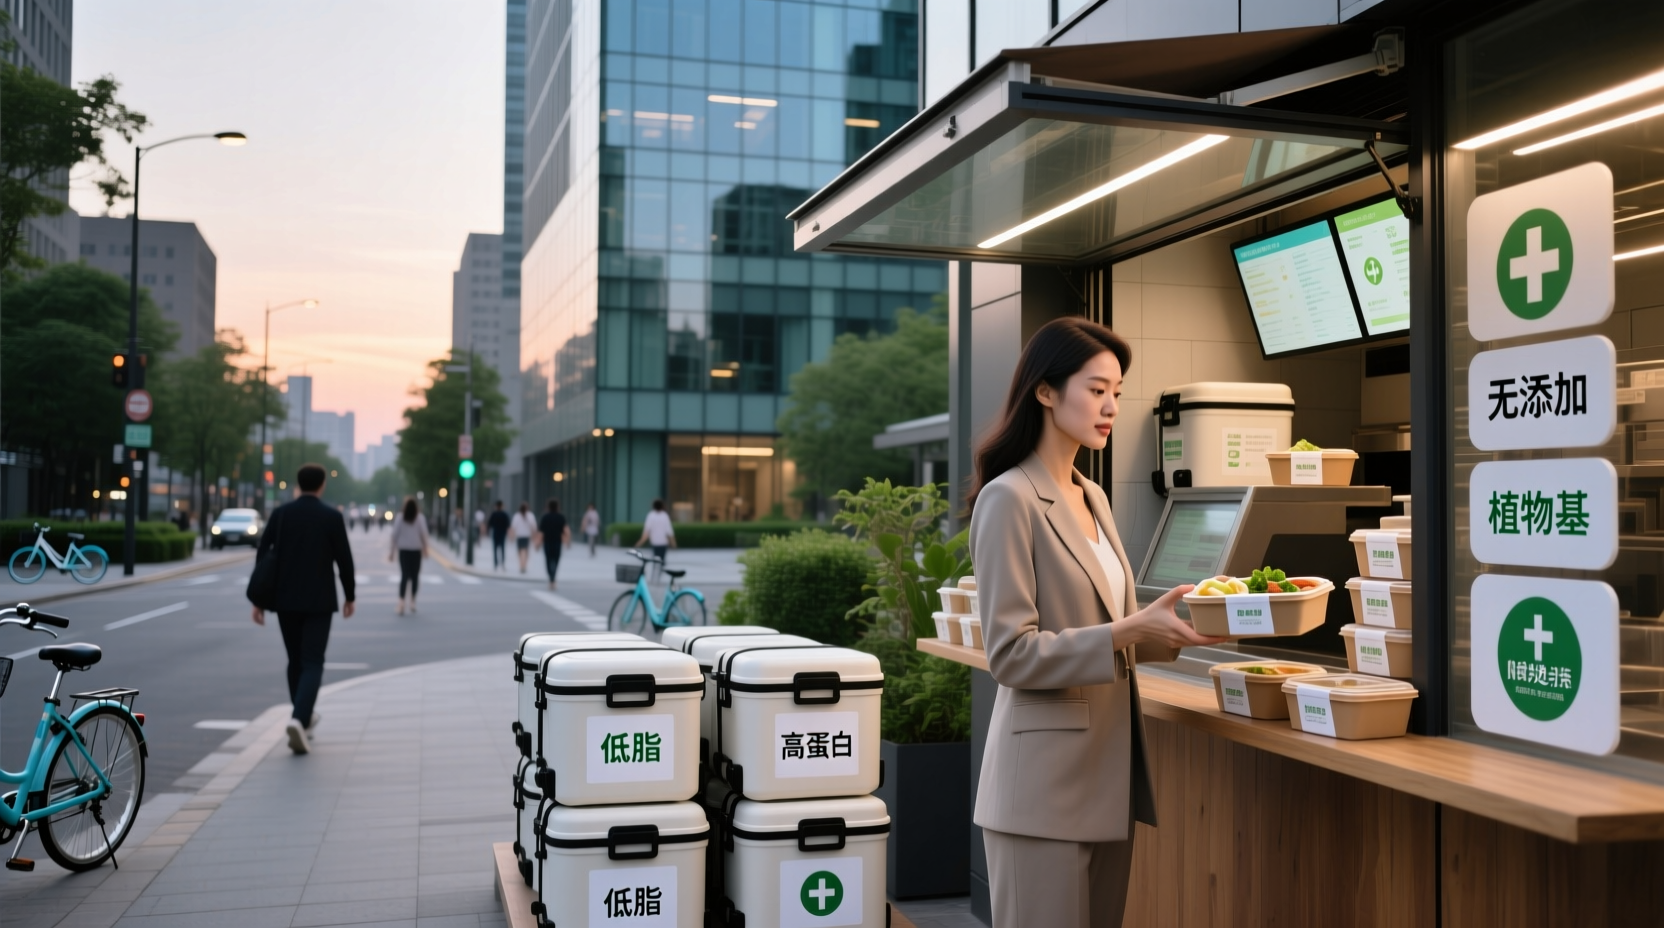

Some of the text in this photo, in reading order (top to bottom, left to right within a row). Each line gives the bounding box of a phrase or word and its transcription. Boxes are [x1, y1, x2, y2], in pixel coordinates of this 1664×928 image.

[1488, 372, 1587, 421] 无添加
[1488, 490, 1590, 536] 植物基
[600, 731, 662, 764] 低脂
[780, 730, 852, 760] 高蛋白
[603, 885, 662, 919] 低脂
